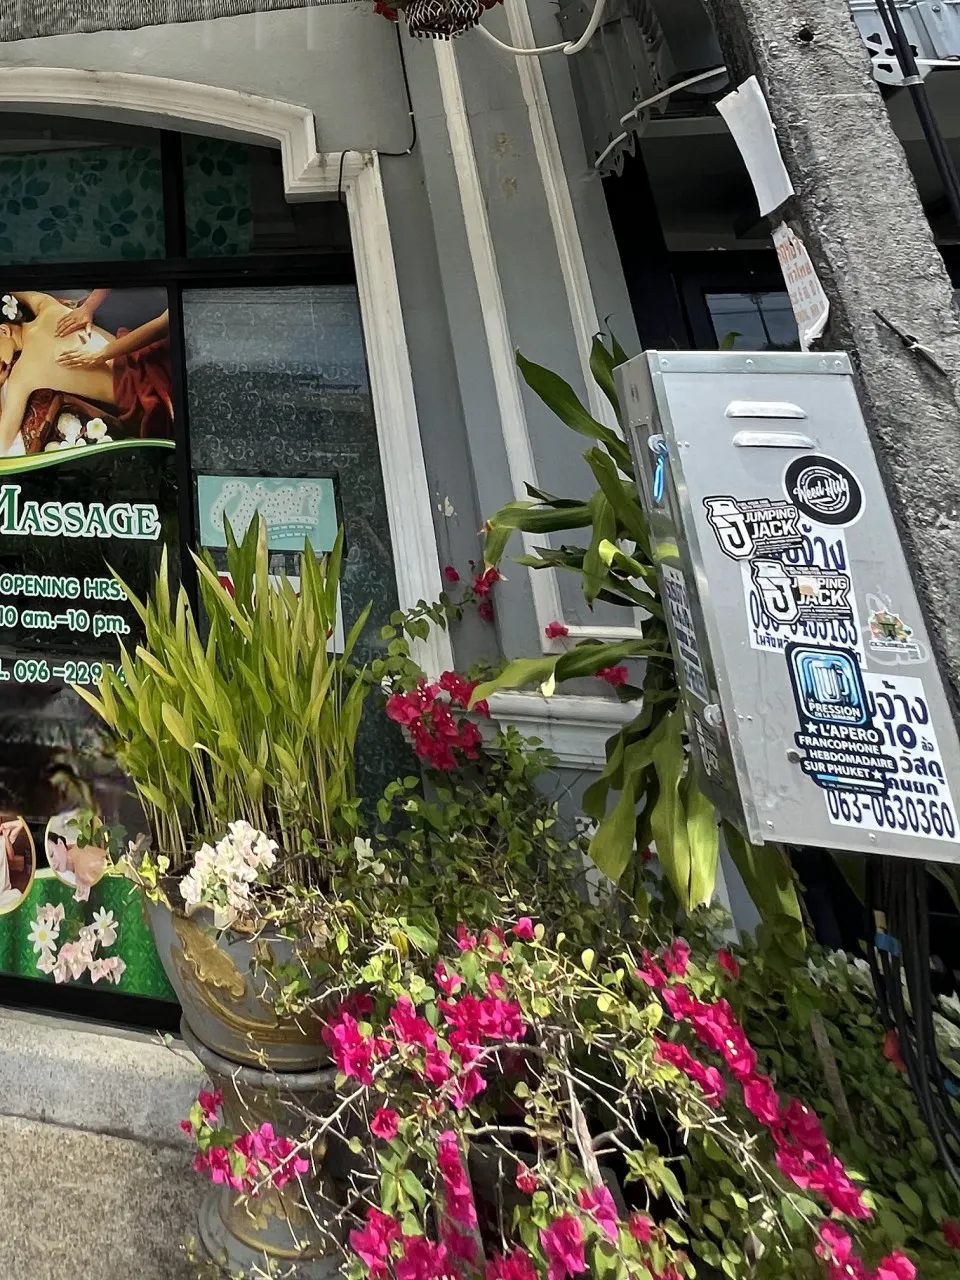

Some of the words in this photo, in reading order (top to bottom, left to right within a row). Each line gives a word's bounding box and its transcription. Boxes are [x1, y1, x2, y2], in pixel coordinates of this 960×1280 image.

[745, 507, 796, 523] JUMPING
[751, 519, 796, 539] JACK
[84, 577, 128, 601] HRS.
[791, 576, 846, 589] JPING
[93, 614, 131, 638] pm.
[13, 659, 51, 683] 096
[808, 703, 861, 718] PRESSION
[819, 723, 879, 743] L'APERO
[884, 721, 917, 749] 10
[798, 735, 881, 755] FRANCOPHONE
[809, 749, 895, 770] HEBDOMADAIRE
[804, 761, 826, 773] SUR
[827, 763, 871, 779] PHUKET
[827, 790, 955, 839] 063-0630360
